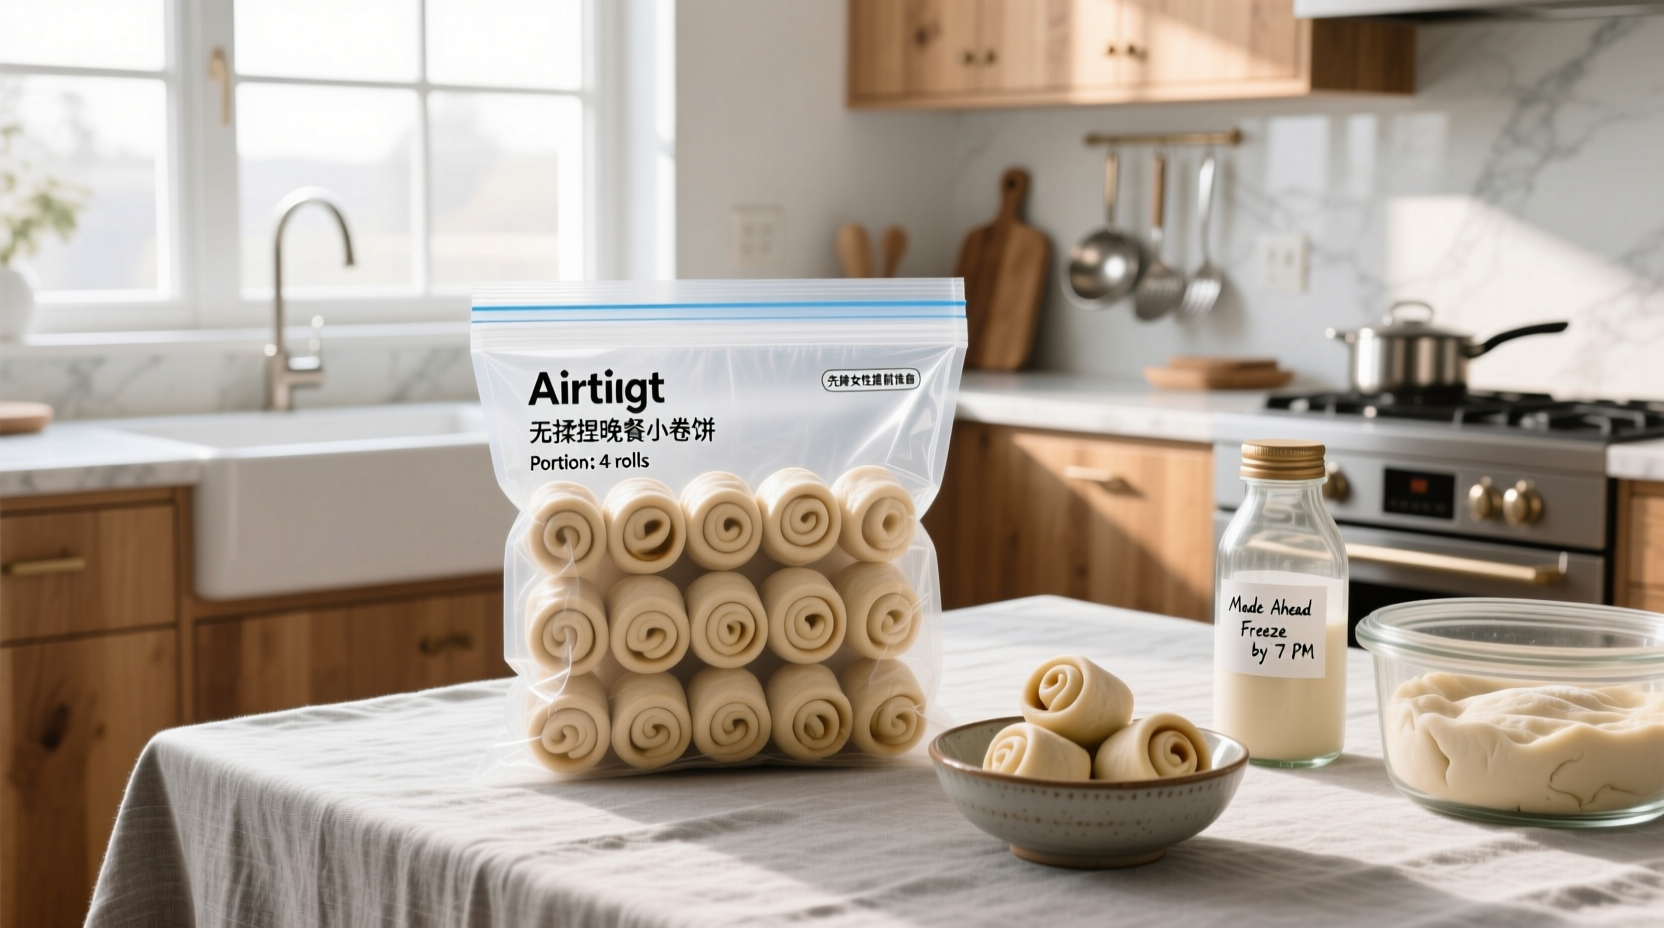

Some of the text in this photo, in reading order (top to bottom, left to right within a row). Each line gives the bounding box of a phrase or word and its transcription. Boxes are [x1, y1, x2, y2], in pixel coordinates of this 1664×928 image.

[529, 416, 716, 444] 无揉捏晚餐小卷饼
[530, 452, 650, 471] Portion: 4 rolls
[1228, 595, 1312, 616] Made Ahead
[1241, 620, 1288, 638] Freeze
[1251, 641, 1315, 665] by 7 PM
